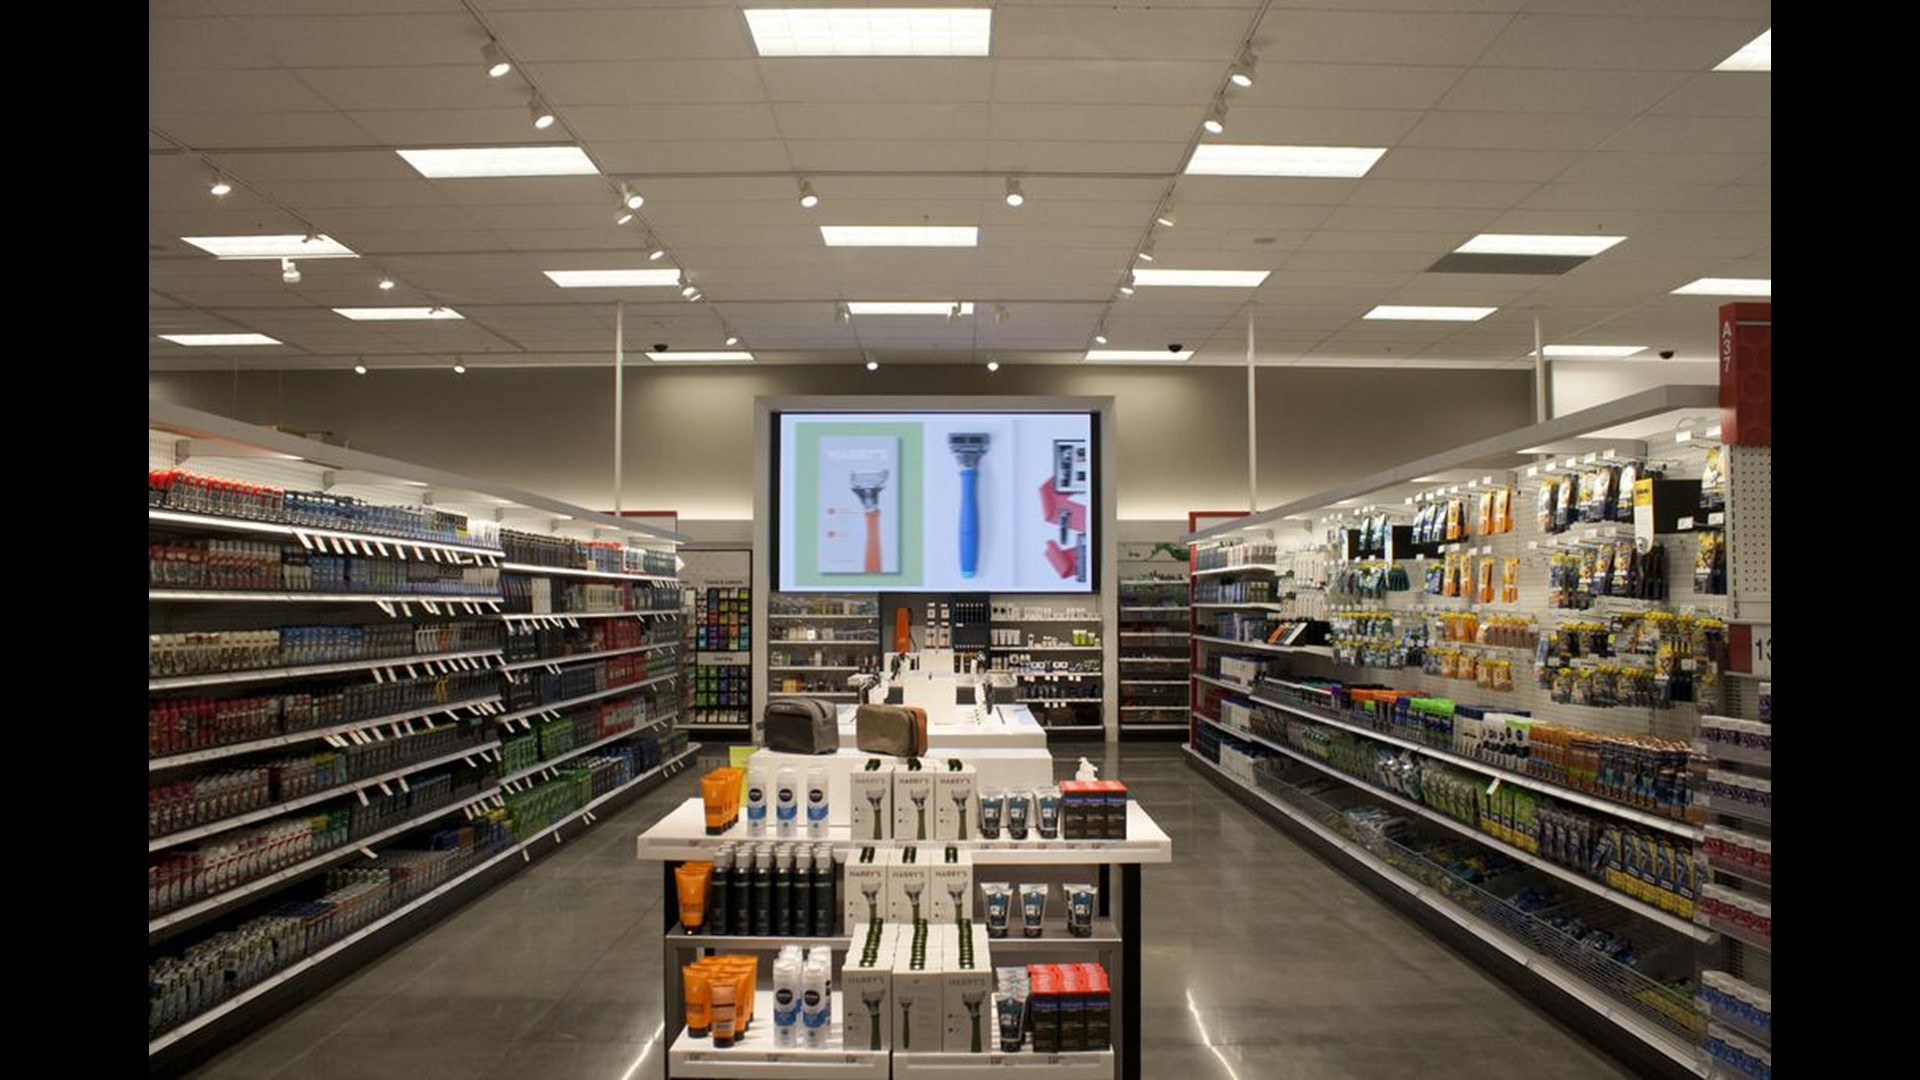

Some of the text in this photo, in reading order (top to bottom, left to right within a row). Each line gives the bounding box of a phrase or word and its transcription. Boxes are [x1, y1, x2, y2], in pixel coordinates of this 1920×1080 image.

[1721, 321, 1733, 373] A37
[849, 870, 882, 878] HARRY'S
[892, 871, 925, 879] HARRY'S
[935, 870, 968, 878] HARRY'S
